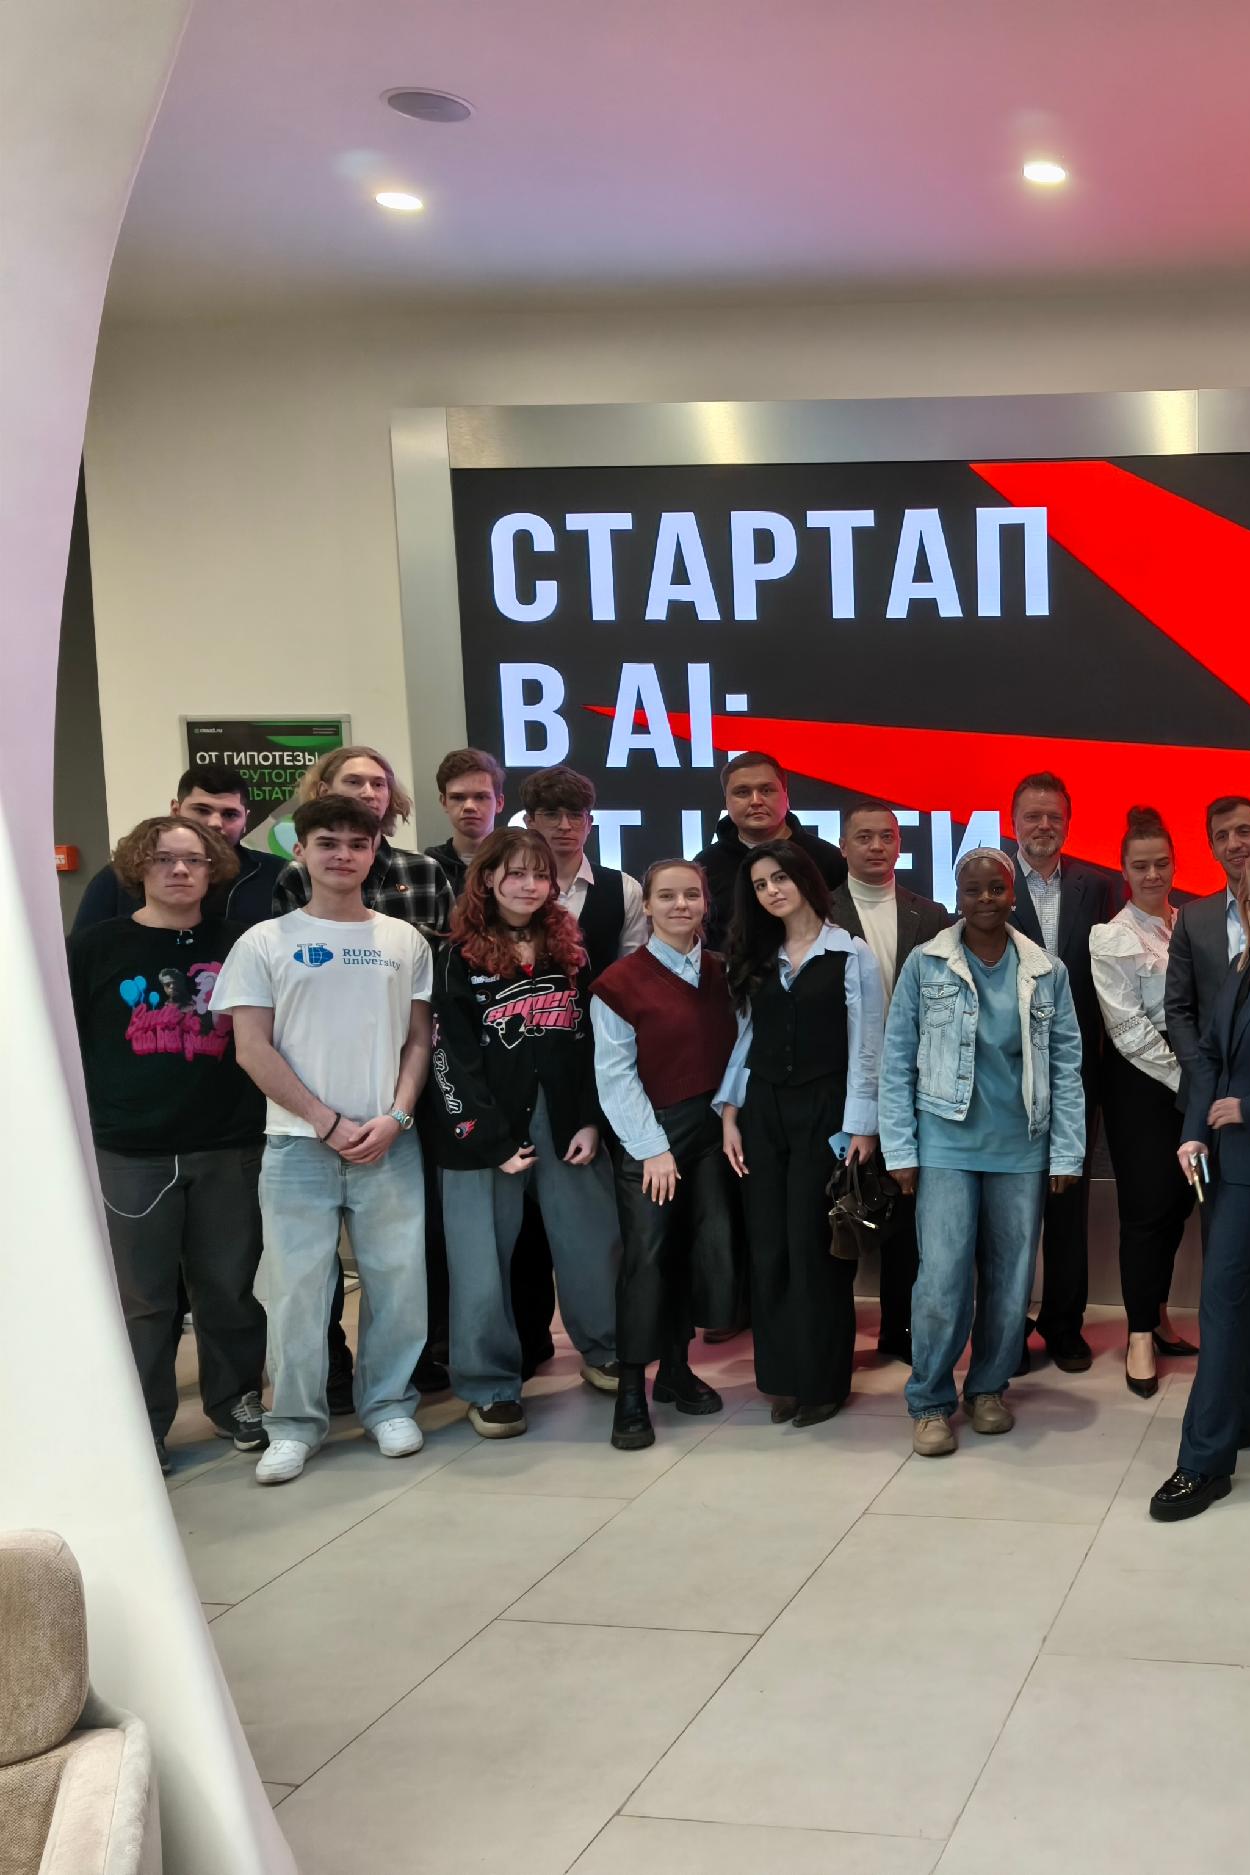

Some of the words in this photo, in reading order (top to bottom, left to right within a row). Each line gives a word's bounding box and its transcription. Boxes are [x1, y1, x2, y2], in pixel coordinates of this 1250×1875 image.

[490, 506, 1050, 623] СТАРТАП
[499, 662, 569, 768] В
[196, 751, 219, 765] ОТ
[239, 769, 308, 783] РУТОГО
[342, 948, 382, 958] RUDN
[342, 956, 401, 971] university
